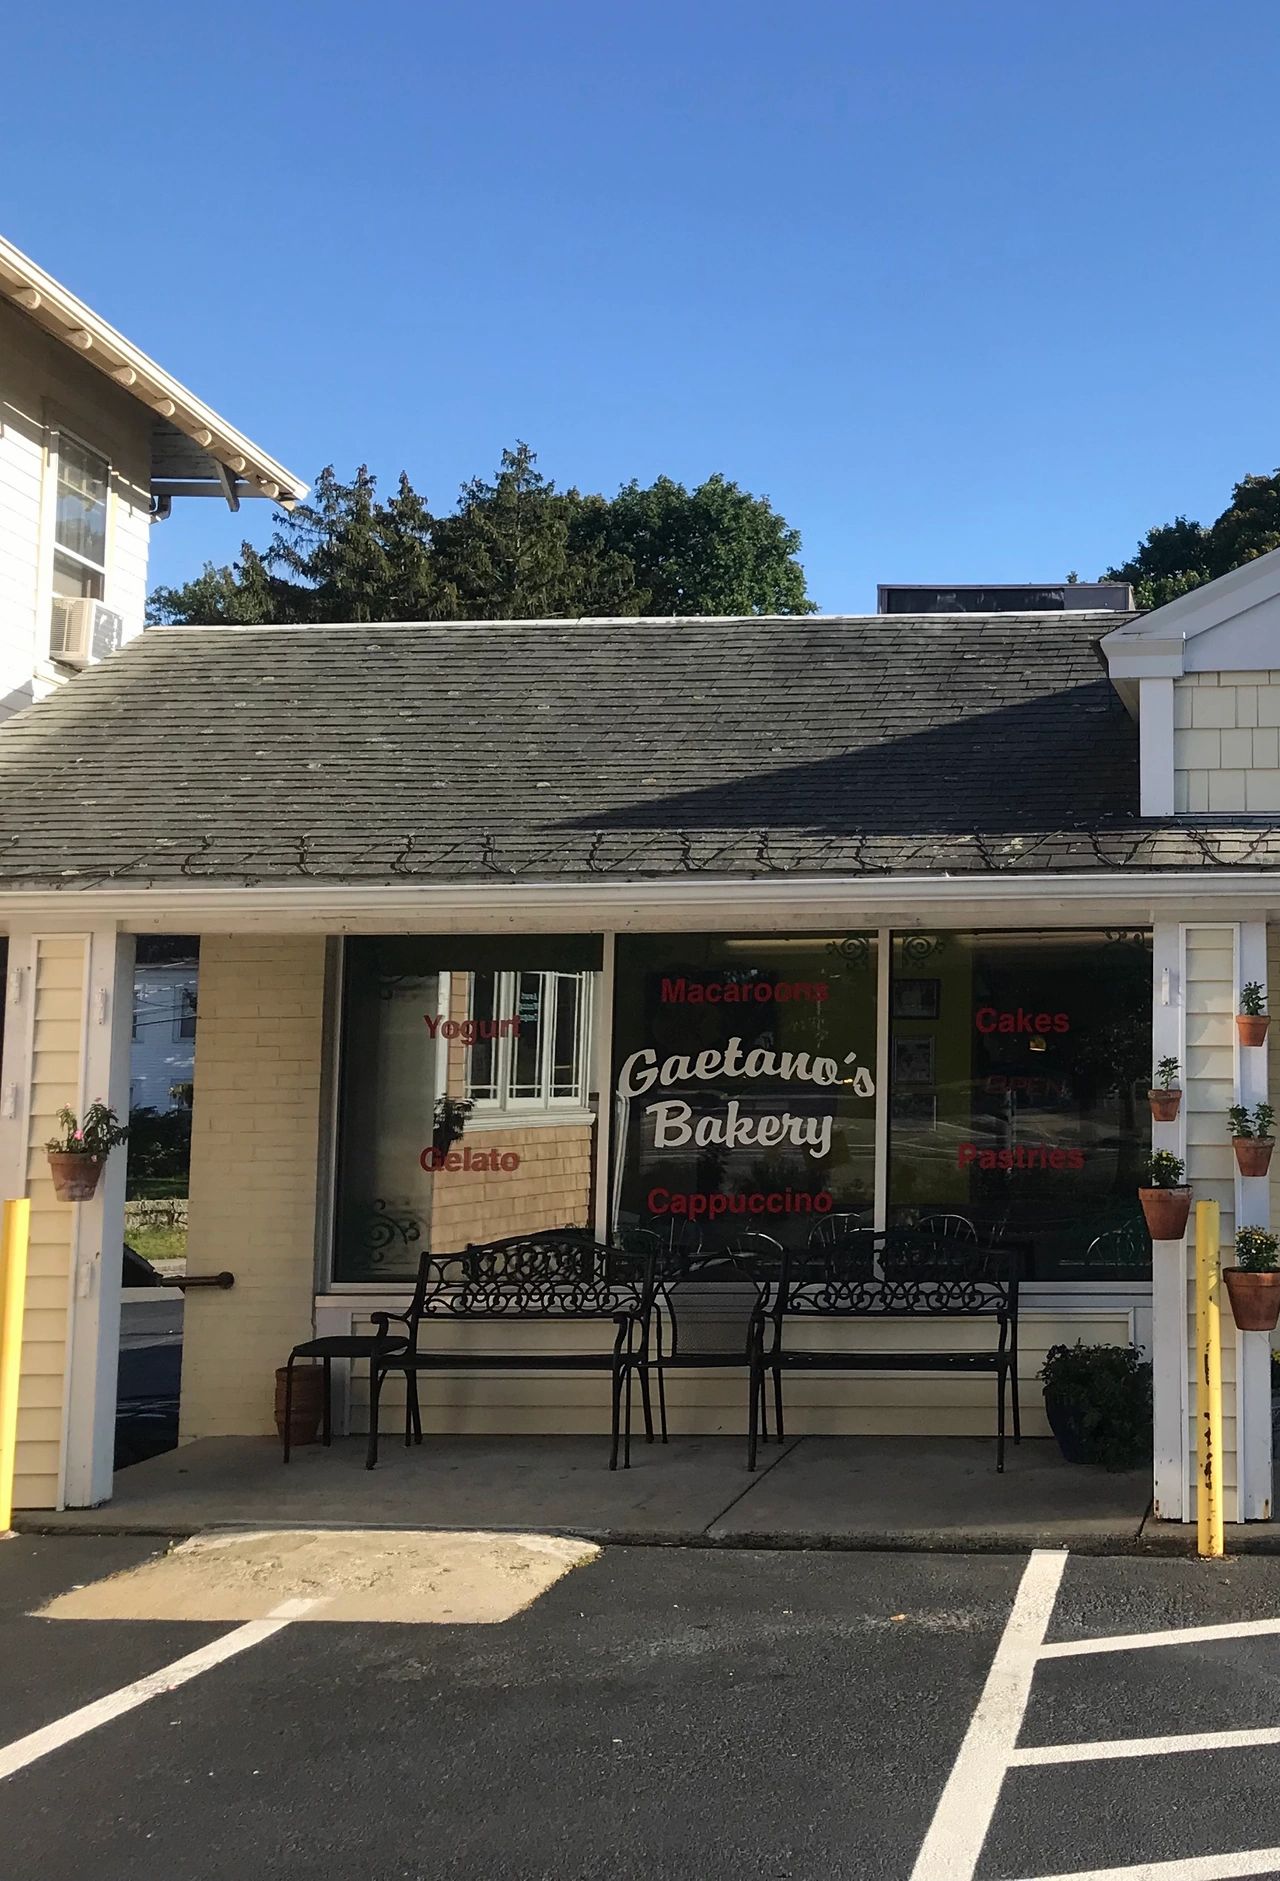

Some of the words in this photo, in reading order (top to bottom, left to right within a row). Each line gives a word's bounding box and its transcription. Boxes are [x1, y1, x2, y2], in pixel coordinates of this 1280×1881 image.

[660, 977, 831, 1005] Macaroons
[422, 1013, 523, 1044] Yogurt
[974, 1007, 1070, 1034] Cakes
[617, 1037, 877, 1099] Gaetano's
[646, 1102, 834, 1160] Bakery
[419, 1145, 521, 1173] Gelato
[956, 1142, 1086, 1171] Pastries
[646, 1186, 833, 1222] Cappuccino
